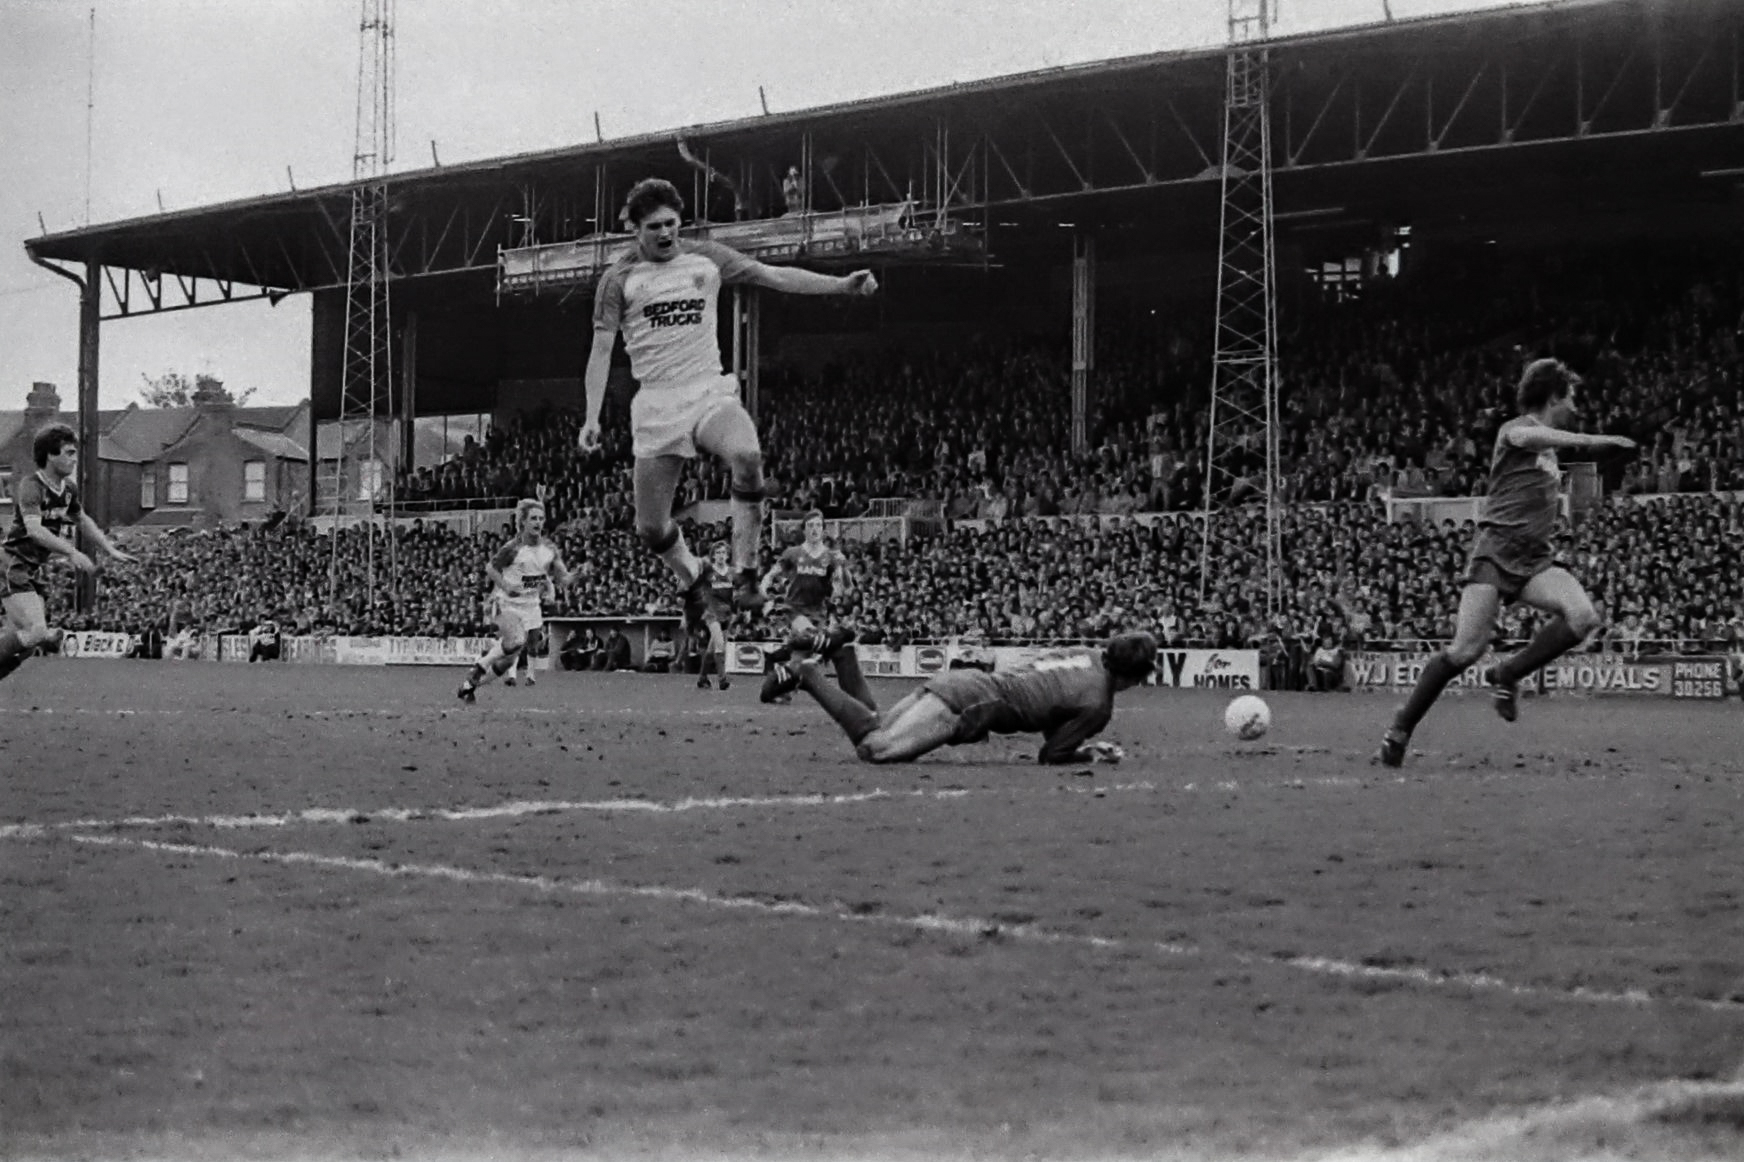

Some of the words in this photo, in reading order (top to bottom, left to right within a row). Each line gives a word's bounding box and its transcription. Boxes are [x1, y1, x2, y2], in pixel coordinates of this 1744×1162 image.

[643, 298, 706, 318] BEDFORD
[649, 312, 703, 328] TRUCKS
[1674, 662, 1722, 678] PHONE
[1193, 674, 1251, 690] HOMES
